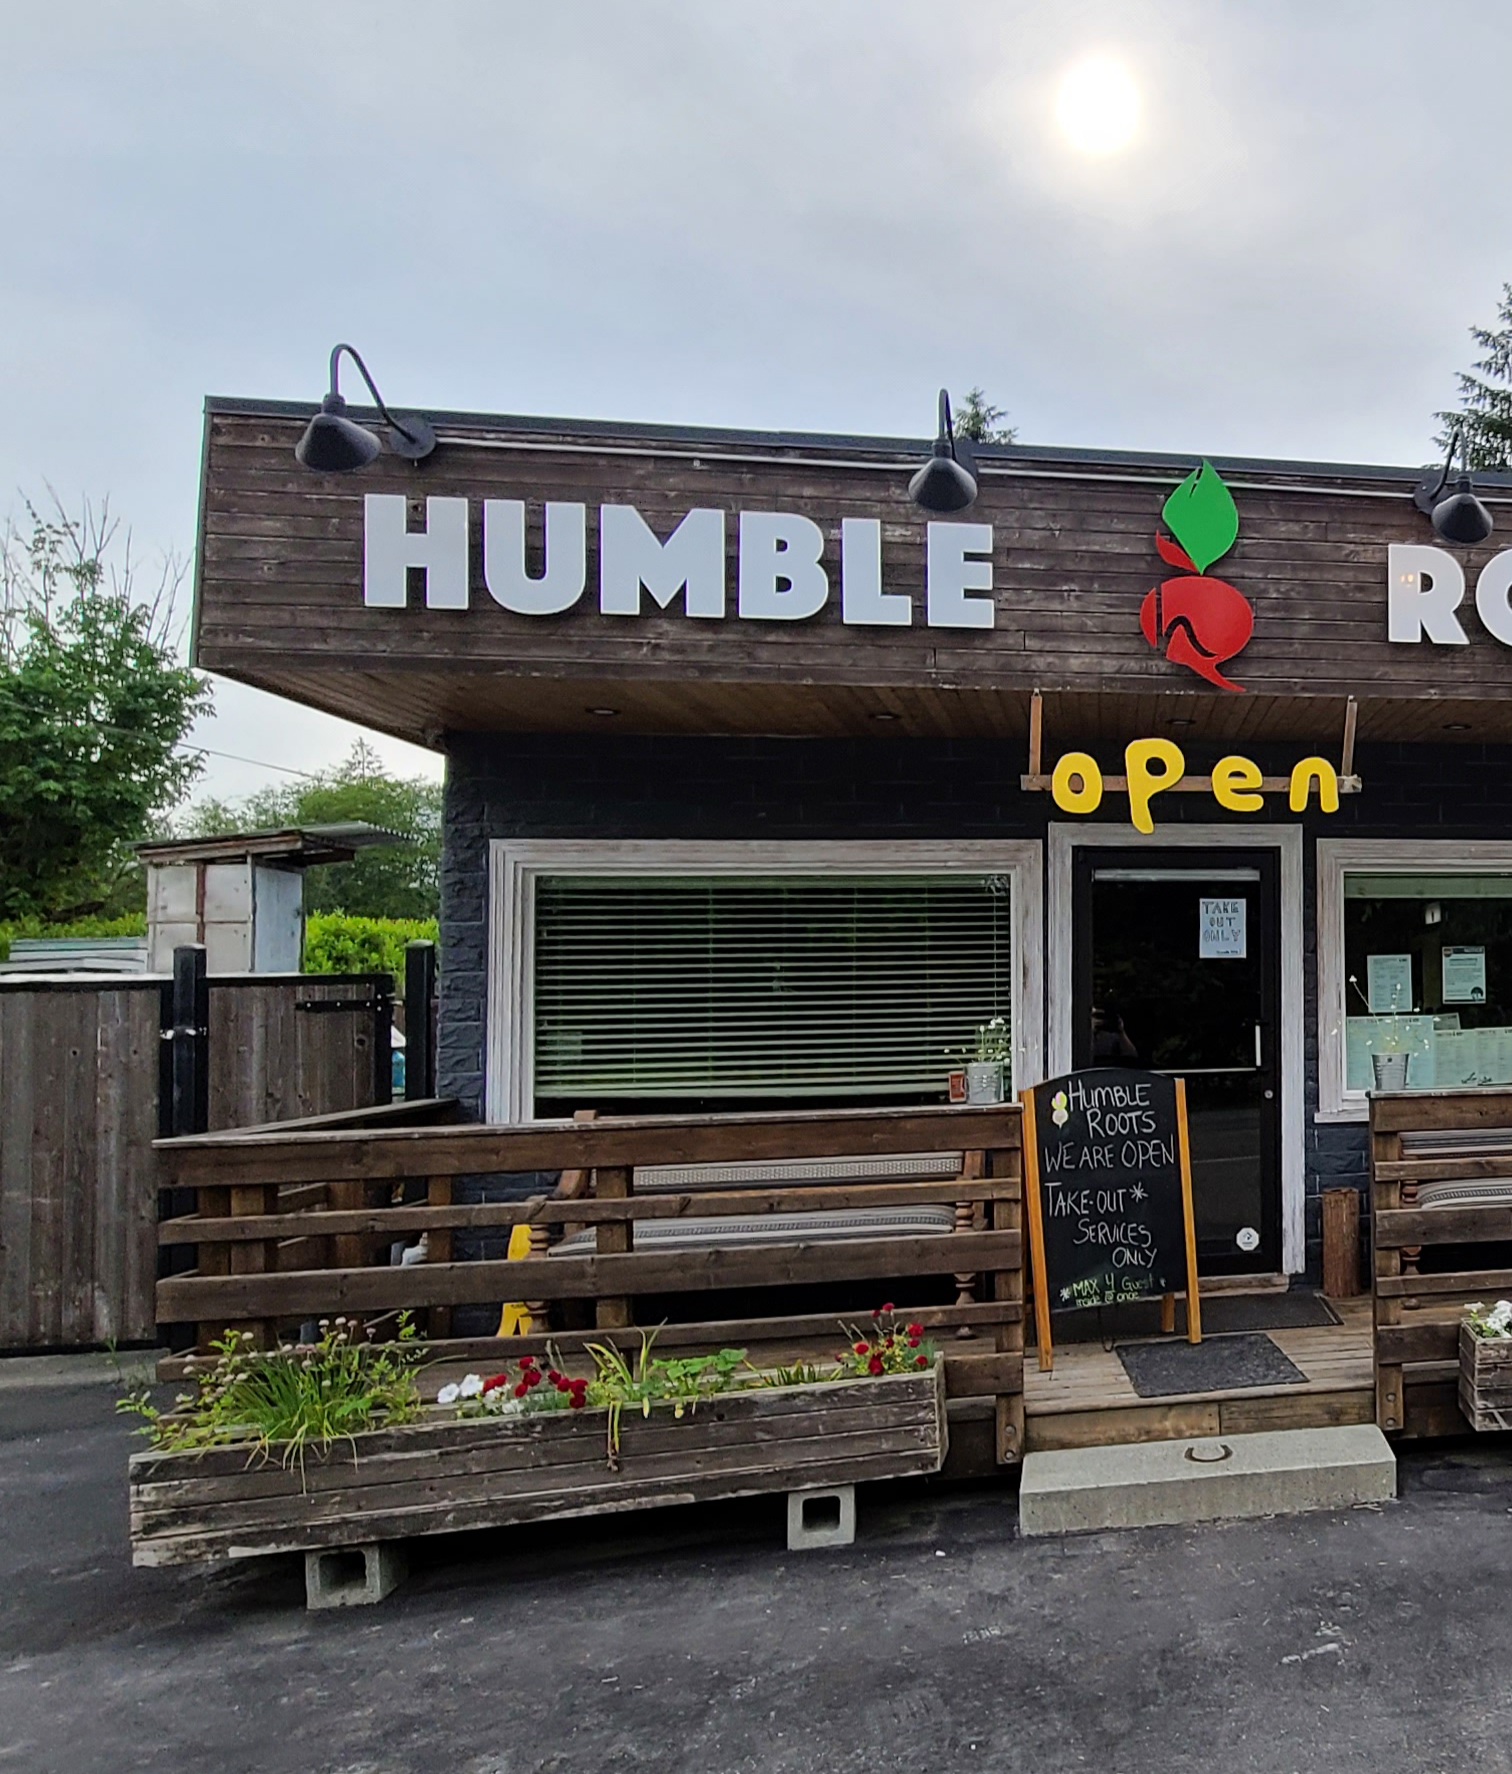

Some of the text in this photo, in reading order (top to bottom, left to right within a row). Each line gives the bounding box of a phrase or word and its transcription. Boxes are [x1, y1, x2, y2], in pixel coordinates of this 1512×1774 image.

[364, 493, 995, 629] HUMBLE
[1202, 901, 1239, 914] TAKE
[1209, 916, 1236, 927] OUT
[1204, 928, 1241, 942] ONLY
[1068, 1078, 1152, 1112] HUMBLE
[1086, 1107, 1157, 1139] ROOTS
[1044, 1133, 1175, 1173] WE ARE OPEN
[1073, 1218, 1152, 1248] SERVICES
[1112, 1246, 1158, 1268] ONLY
[1072, 1279, 1101, 1297] MAX
